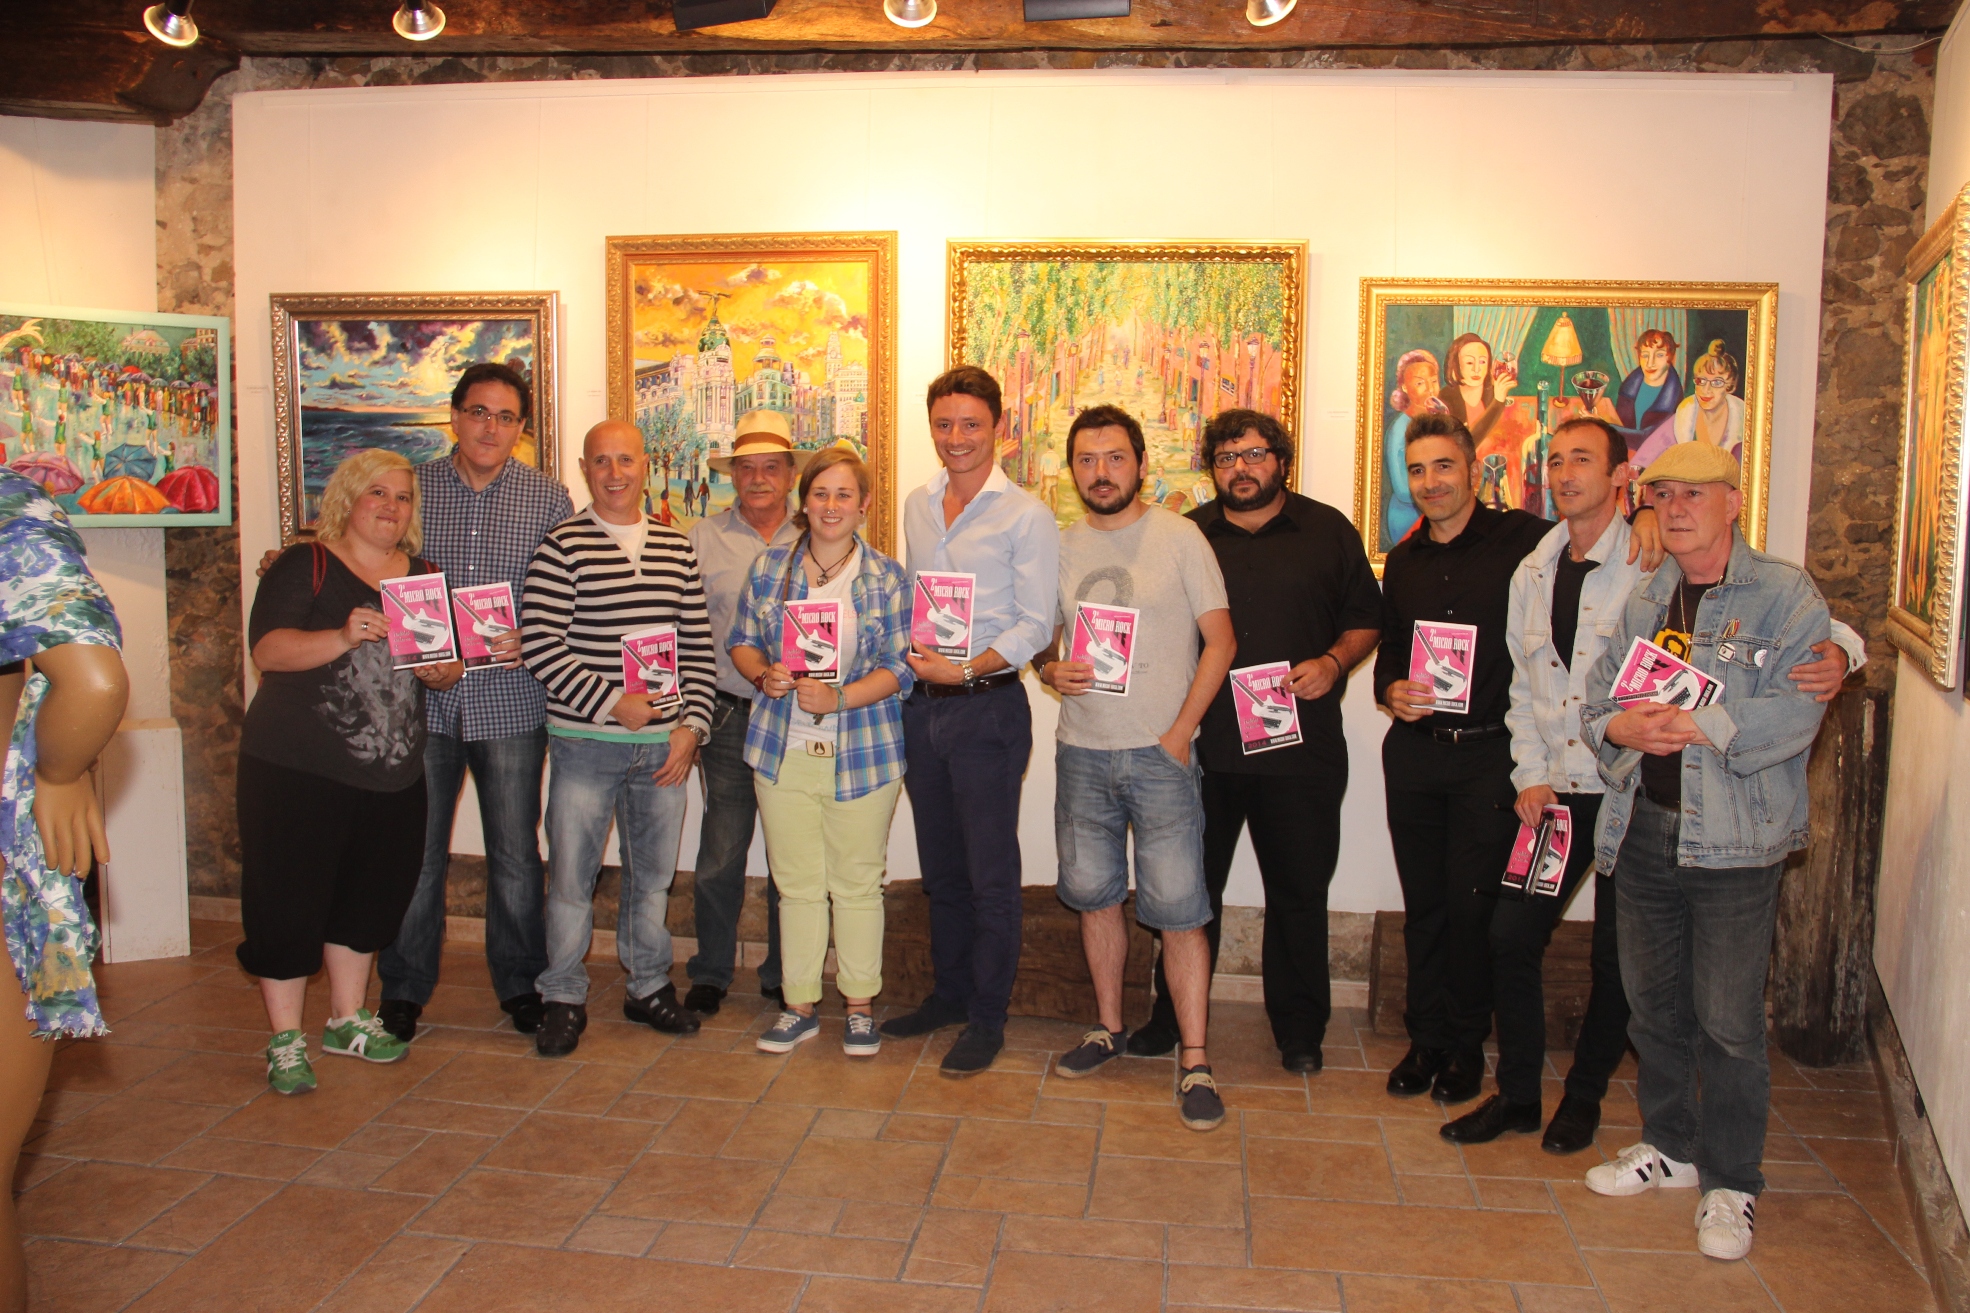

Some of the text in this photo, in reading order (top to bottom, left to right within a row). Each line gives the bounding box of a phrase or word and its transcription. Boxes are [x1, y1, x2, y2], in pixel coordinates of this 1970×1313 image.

[404, 589, 424, 603] MICRO
[425, 587, 443, 601] ROCK
[934, 585, 953, 597] MICRO
[953, 586, 970, 599] ROCK
[473, 598, 493, 611] MICRO
[493, 595, 510, 609] ROCK
[801, 612, 820, 624] MICRO
[820, 611, 836, 623] ROCK
[1094, 618, 1115, 632] MICRO
[1115, 620, 1132, 634] ROCK
[641, 643, 658, 657] MICRO
[658, 640, 674, 653] ROCK
[1432, 636, 1453, 649] MICRO
[1453, 638, 1470, 651] ROCK
[1629, 667, 1649, 691] MICRO
[1640, 648, 1658, 671] ROCK
[1252, 678, 1271, 692] MICRO
[1248, 740, 1267, 749] 2014
